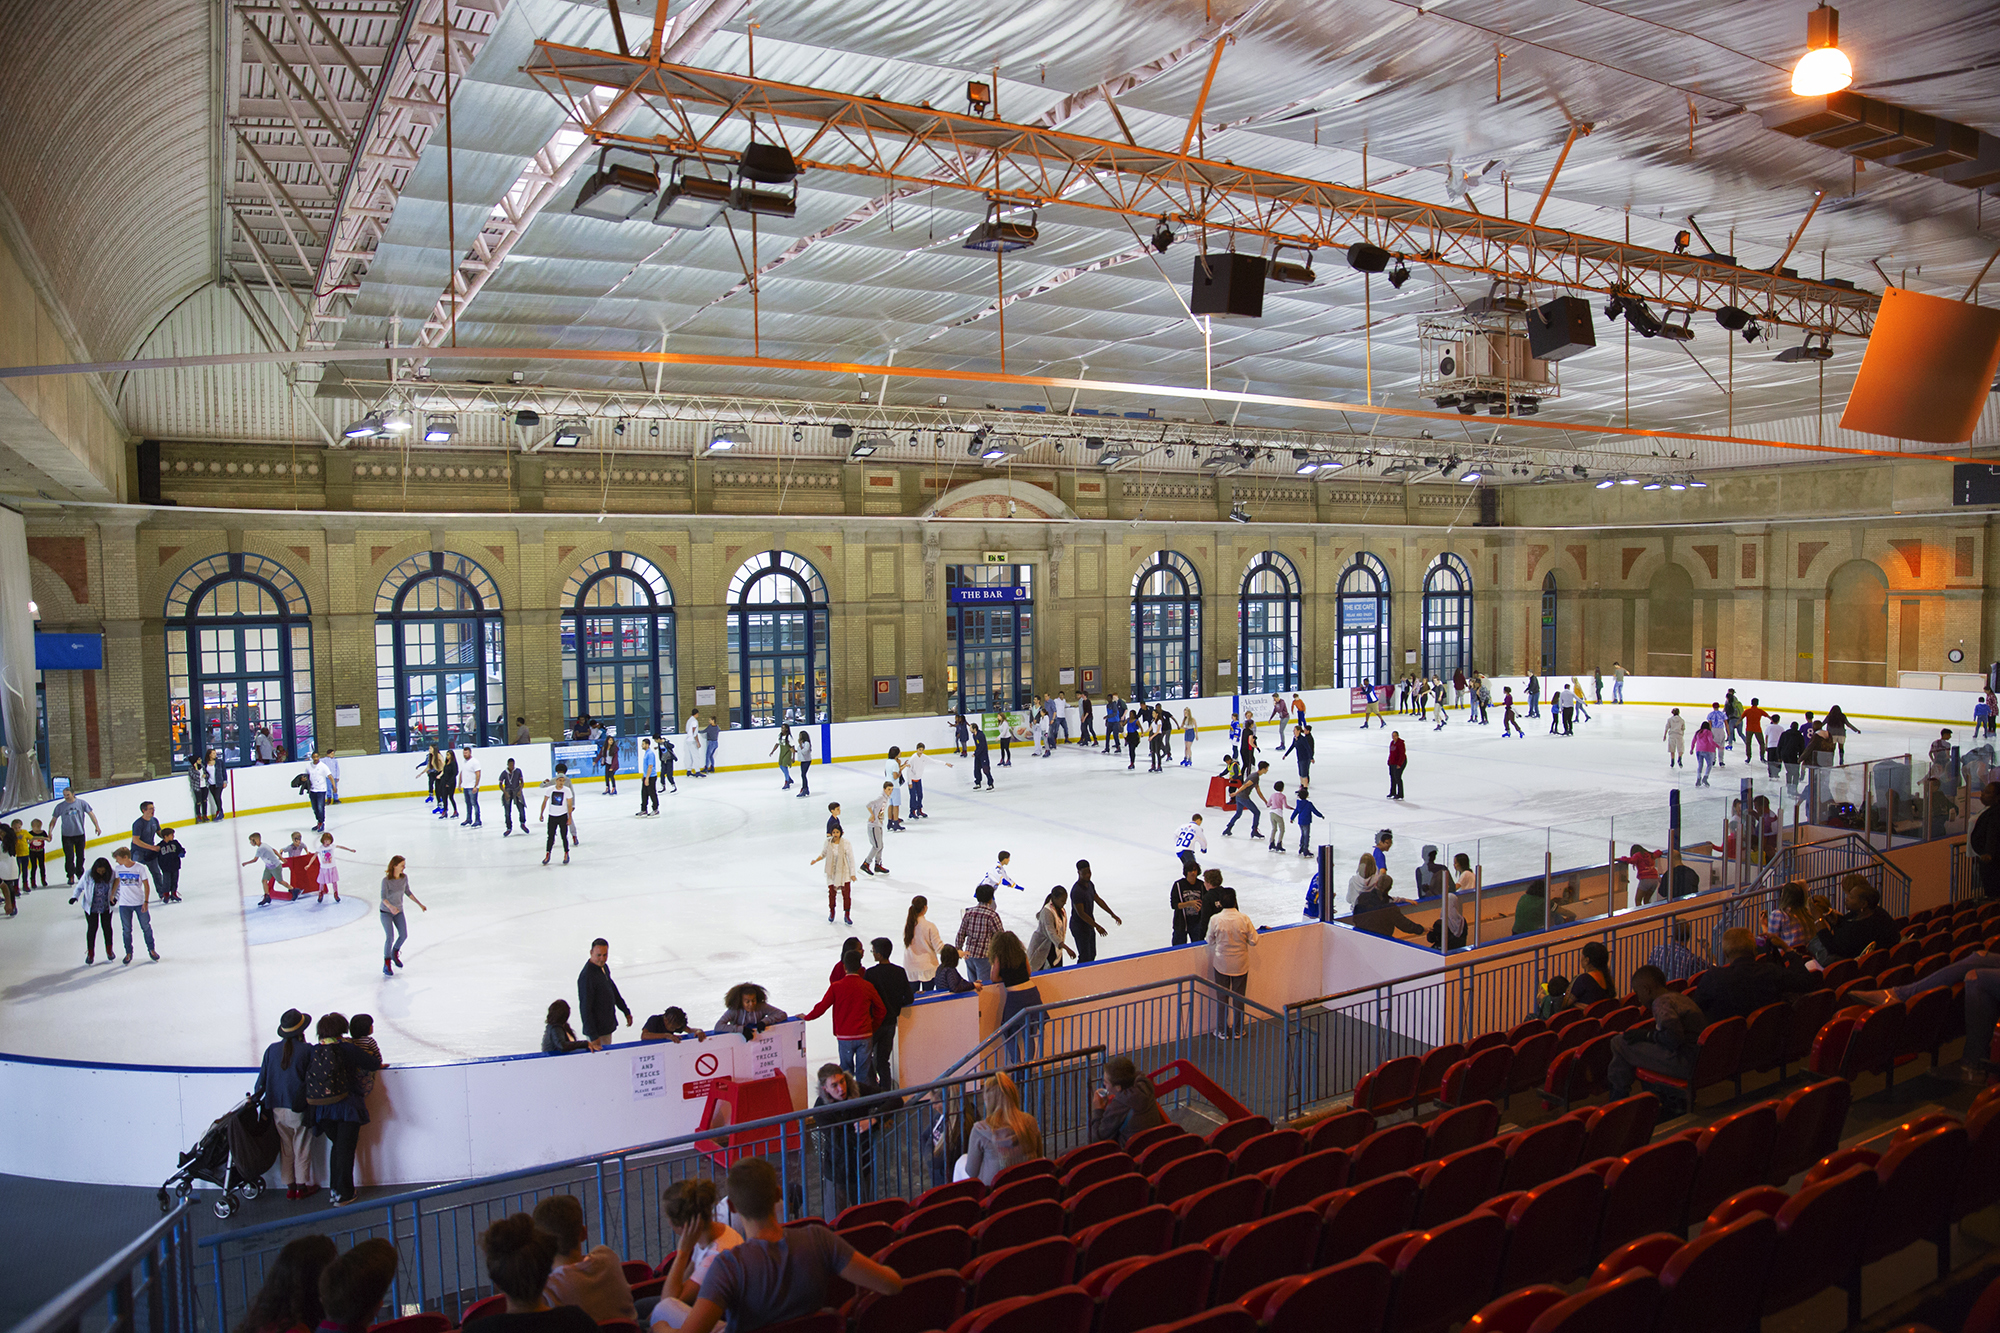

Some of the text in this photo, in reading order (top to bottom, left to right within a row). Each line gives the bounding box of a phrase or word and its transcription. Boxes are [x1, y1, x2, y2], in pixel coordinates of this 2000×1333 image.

[961, 590, 1003, 599] THE BAR
[1241, 697, 1268, 706] Alexandra
[1176, 831, 1195, 848] 68
[759, 1037, 774, 1045] TIPS
[756, 1051, 778, 1061] TRICKS
[760, 1060, 774, 1068] ZONE
[636, 1070, 660, 1079] TRICKS
[640, 1078, 656, 1086] ZONE
